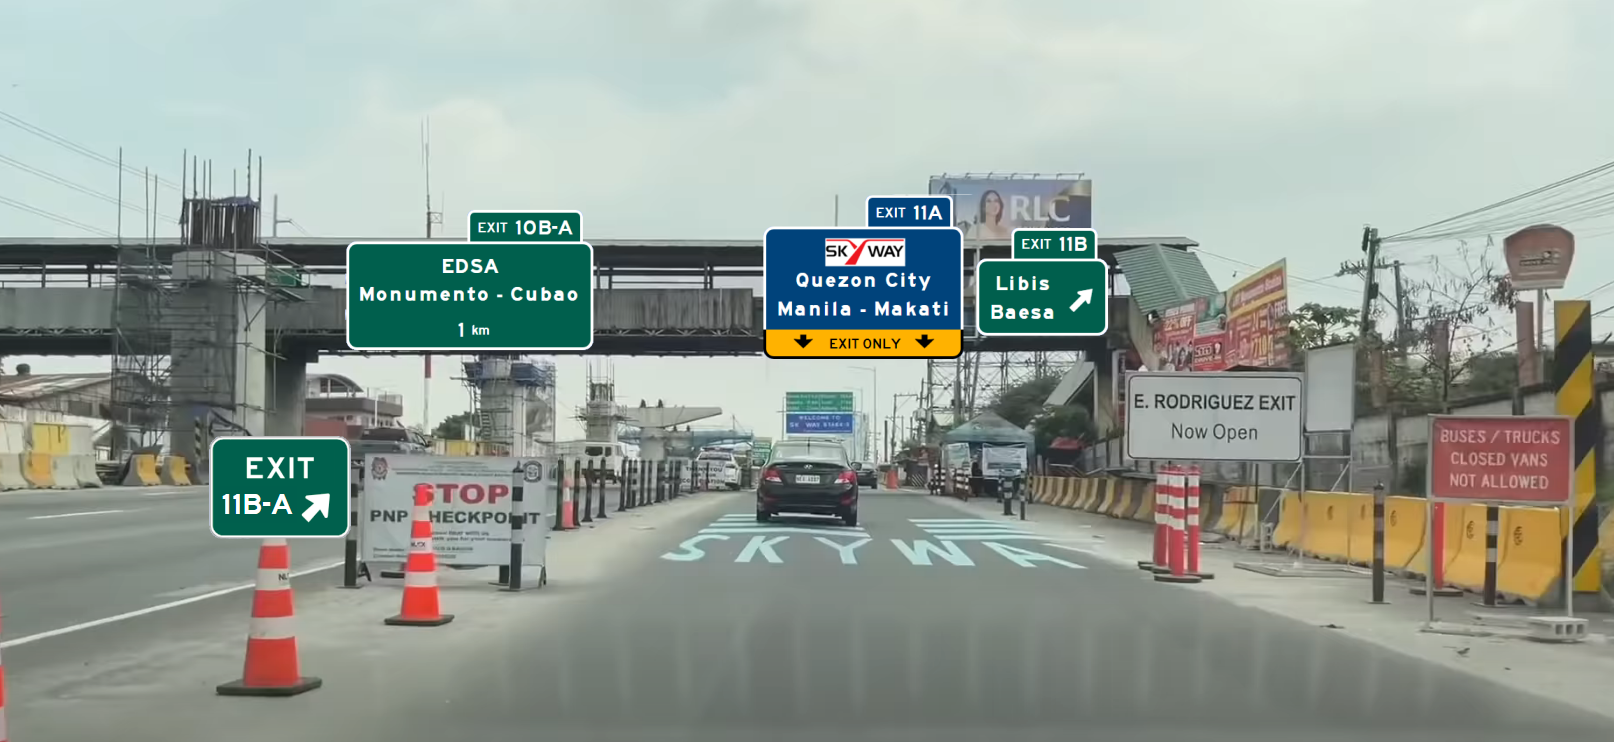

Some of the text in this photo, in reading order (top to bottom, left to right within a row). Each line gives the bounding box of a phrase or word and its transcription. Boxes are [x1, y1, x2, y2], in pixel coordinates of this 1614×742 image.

[875, 205, 943, 221] EXIT 11A
[1010, 194, 1071, 222] RLC
[477, 220, 573, 235] EXIT 10B-A
[1021, 236, 1088, 252] EXIT 11B
[442, 258, 499, 274] EDSA
[796, 272, 932, 291] Quezon City
[996, 275, 1051, 291] Libis
[359, 286, 489, 301] Monumento
[510, 286, 579, 301] Cubao
[777, 300, 852, 317] Manila
[874, 300, 949, 317] Makati
[990, 304, 1055, 320] Baesa
[457, 322, 490, 337] 1 km
[829, 338, 901, 349] EXIT ONLY
[1134, 394, 1296, 410] E. RODRIGUEZ EXIT
[1171, 423, 1258, 443] Now Open
[1440, 429, 1486, 443] BUSES
[1504, 430, 1561, 444] TRUCKS
[1451, 452, 1548, 467] CLOSED VANS
[246, 457, 314, 479] EXIT
[1450, 473, 1549, 489] NOT ALLOWED
[222, 493, 293, 515] 11B-A
[370, 510, 408, 522] PNP
